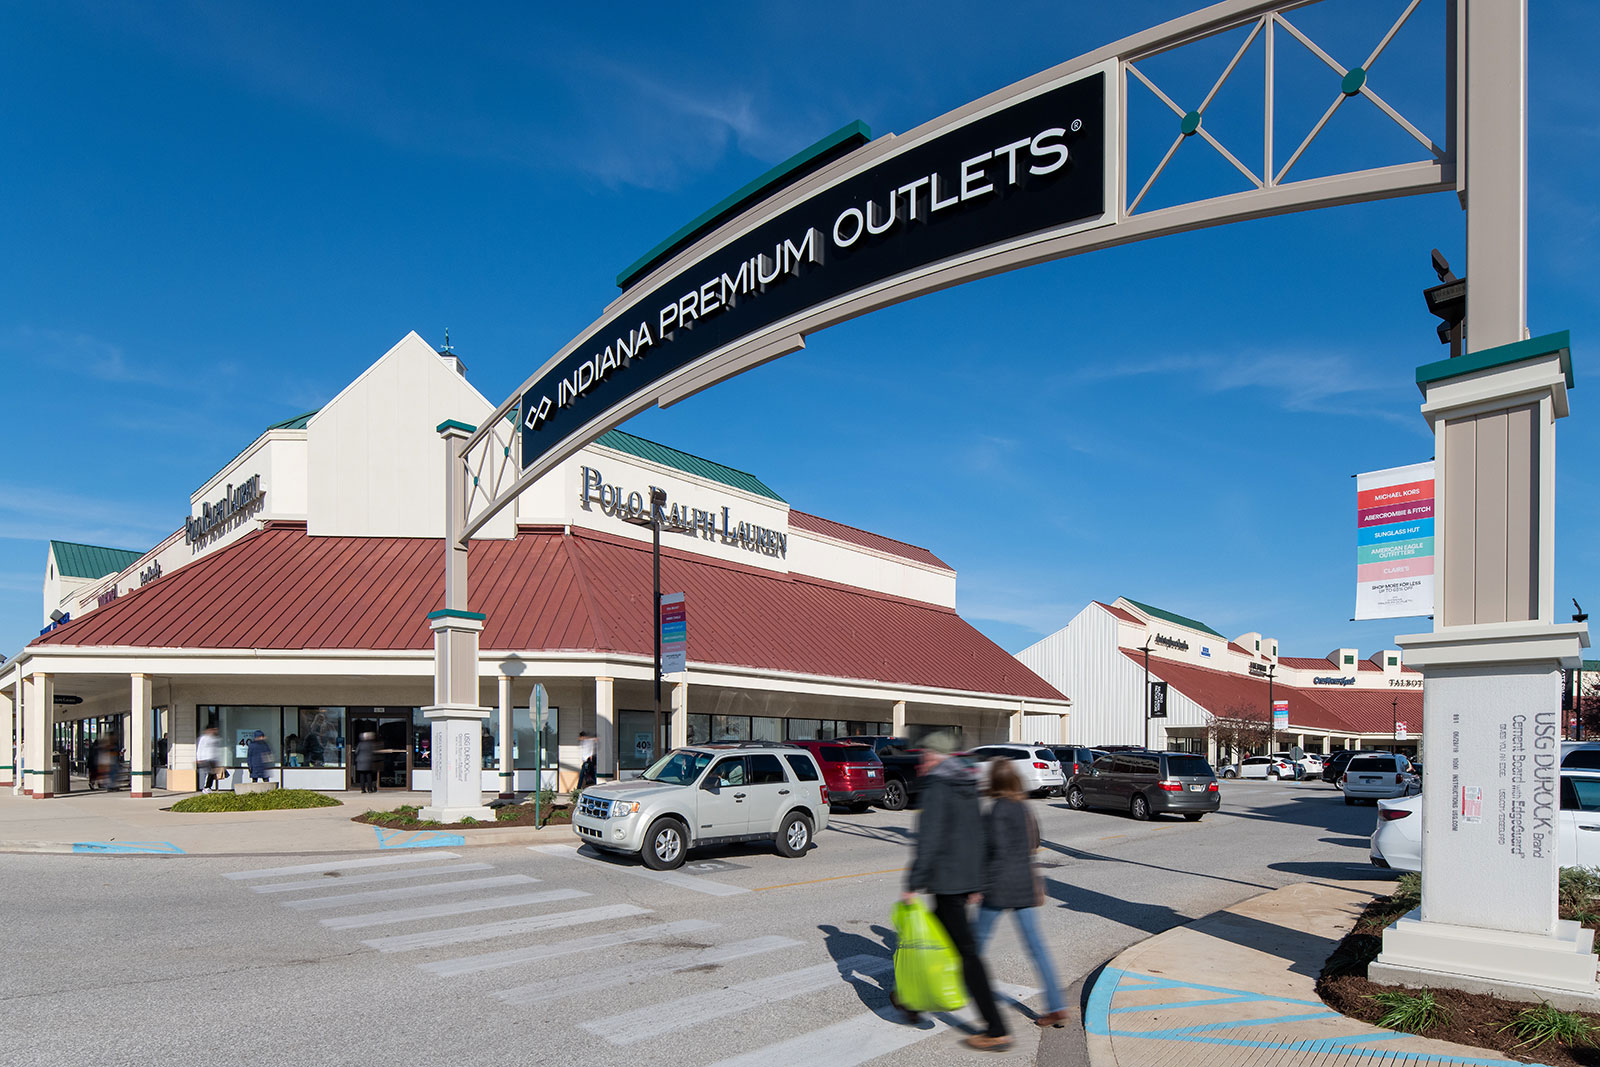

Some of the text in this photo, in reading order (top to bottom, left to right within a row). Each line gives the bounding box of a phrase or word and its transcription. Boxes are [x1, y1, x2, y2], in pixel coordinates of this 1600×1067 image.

[557, 321, 652, 408] INDIANA
[659, 227, 815, 339] PREMIUM
[1374, 488, 1420, 501] MICHAEL KORS
[580, 465, 788, 553] POLO RALPH LAUREN
[1364, 509, 1407, 521] ABERCROMBIE
[1412, 506, 1431, 514] FITCH
[1374, 528, 1406, 539] SUNGLASS
[1370, 542, 1423, 555] AMERICAN EAGLE
[1378, 549, 1415, 559] OUTFITTERS
[1388, 679, 1424, 687] TALBOT
[1511, 714, 1527, 752] Cement
[1511, 754, 1526, 783] Board
[1511, 785, 1523, 799] with
[1532, 712, 1556, 858] USG DUROCK Brand
